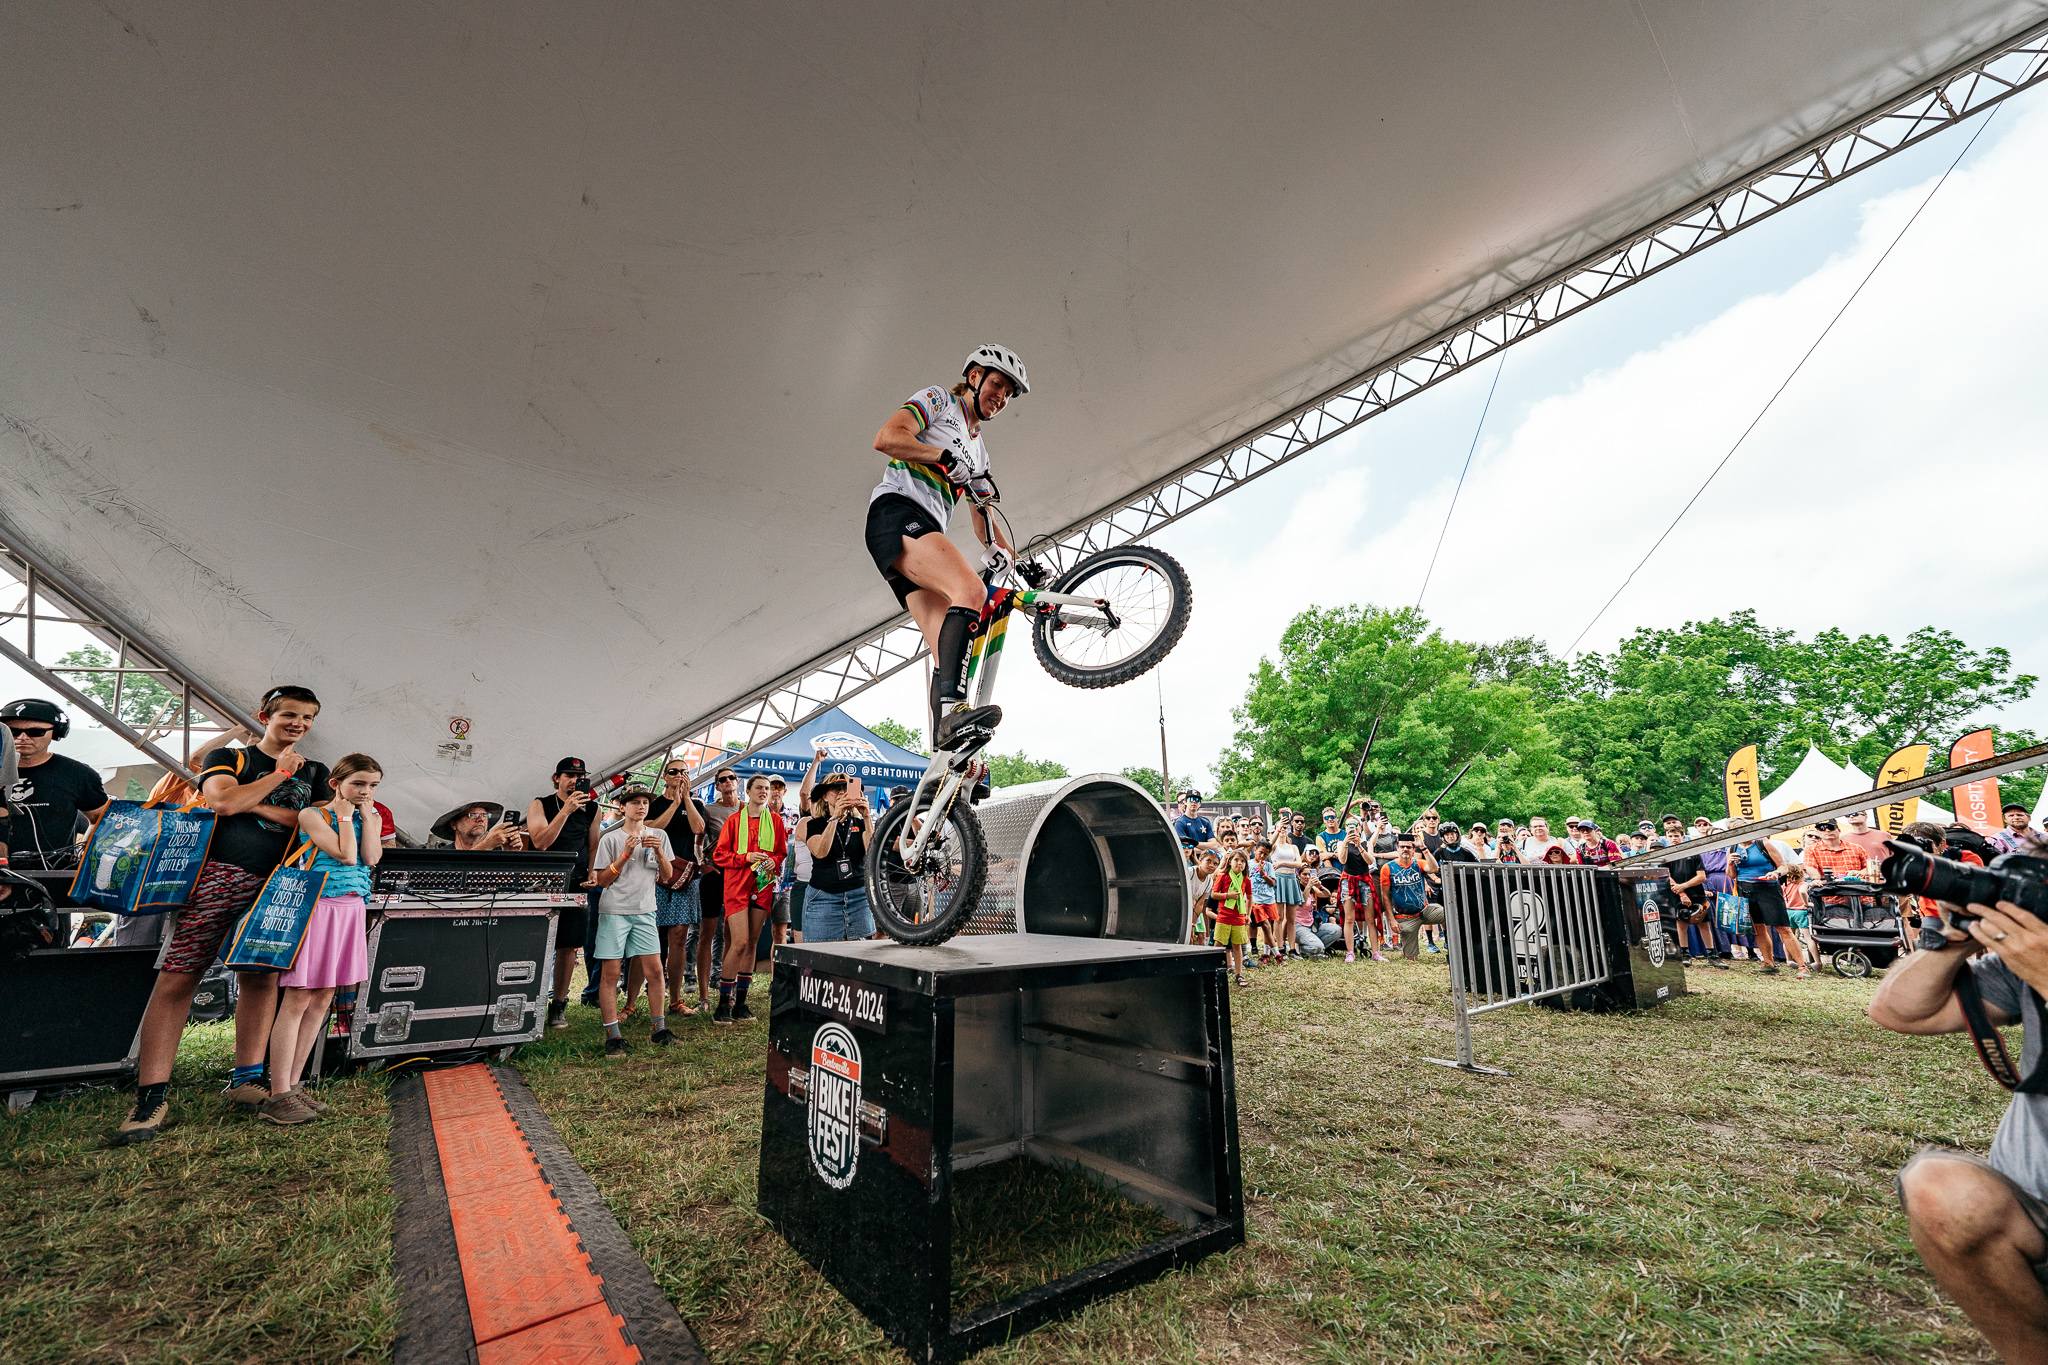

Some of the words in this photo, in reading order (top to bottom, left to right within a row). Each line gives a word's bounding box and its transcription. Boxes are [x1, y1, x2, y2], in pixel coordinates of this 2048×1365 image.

[828, 746, 873, 758] BIKE
[750, 758, 795, 771] FOLLOW
[799, 761, 812, 772] US
[1964, 749, 1989, 830] HOSPITTY
[107, 812, 141, 829] niagara
[168, 834, 189, 847] USED
[187, 833, 198, 846] TO
[162, 849, 171, 859] BE
[170, 848, 193, 859] PLASTIC
[156, 859, 189, 873] BOTTLES!
[279, 876, 292, 890] THIS
[291, 879, 309, 894] BAG
[271, 890, 292, 906] USED
[292, 893, 304, 907] TO
[265, 904, 274, 916] BE
[273, 905, 299, 919] PLASTIC
[260, 916, 295, 933] BOTTLES!
[800, 975, 822, 1005] MAY
[821, 980, 853, 1021] 23-26,
[855, 988, 884, 1025] 2024
[820, 1052, 851, 1076] Bentonville
[818, 1070, 851, 1125] BIKE
[817, 1111, 849, 1170] FEST
